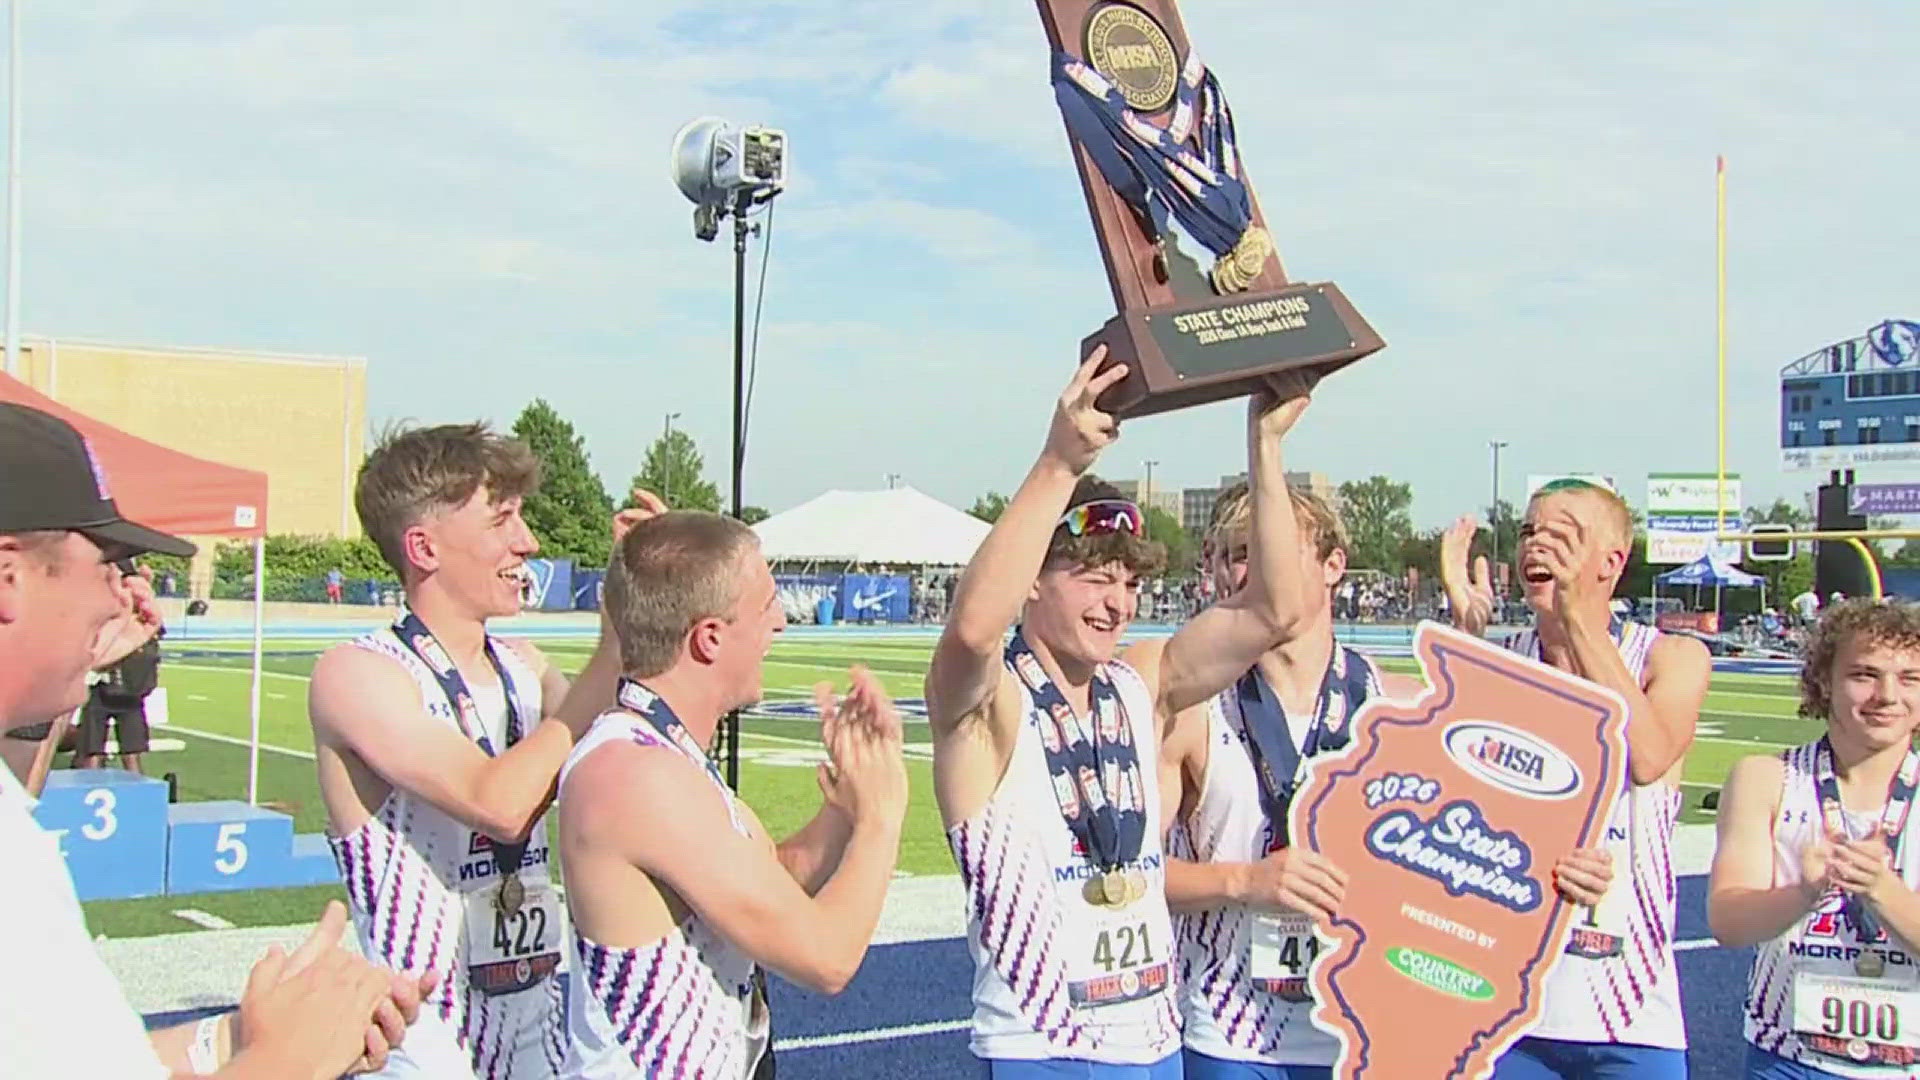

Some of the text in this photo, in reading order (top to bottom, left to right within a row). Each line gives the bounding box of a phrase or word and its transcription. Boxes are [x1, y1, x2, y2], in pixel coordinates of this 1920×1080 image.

[1174, 296, 1310, 333] STATE CHAMPIONS
[81, 788, 118, 841] 3
[1366, 775, 1438, 807] 2026
[215, 822, 248, 875] 5
[1372, 815, 1532, 905] Champion
[1432, 806, 1522, 868] State
[494, 907, 546, 957] 422
[1093, 922, 1154, 972] 421
[1401, 903, 1497, 948] PRESENTED BY
[1398, 948, 1484, 992] COUNTRY
[1822, 997, 1898, 1040] 900
